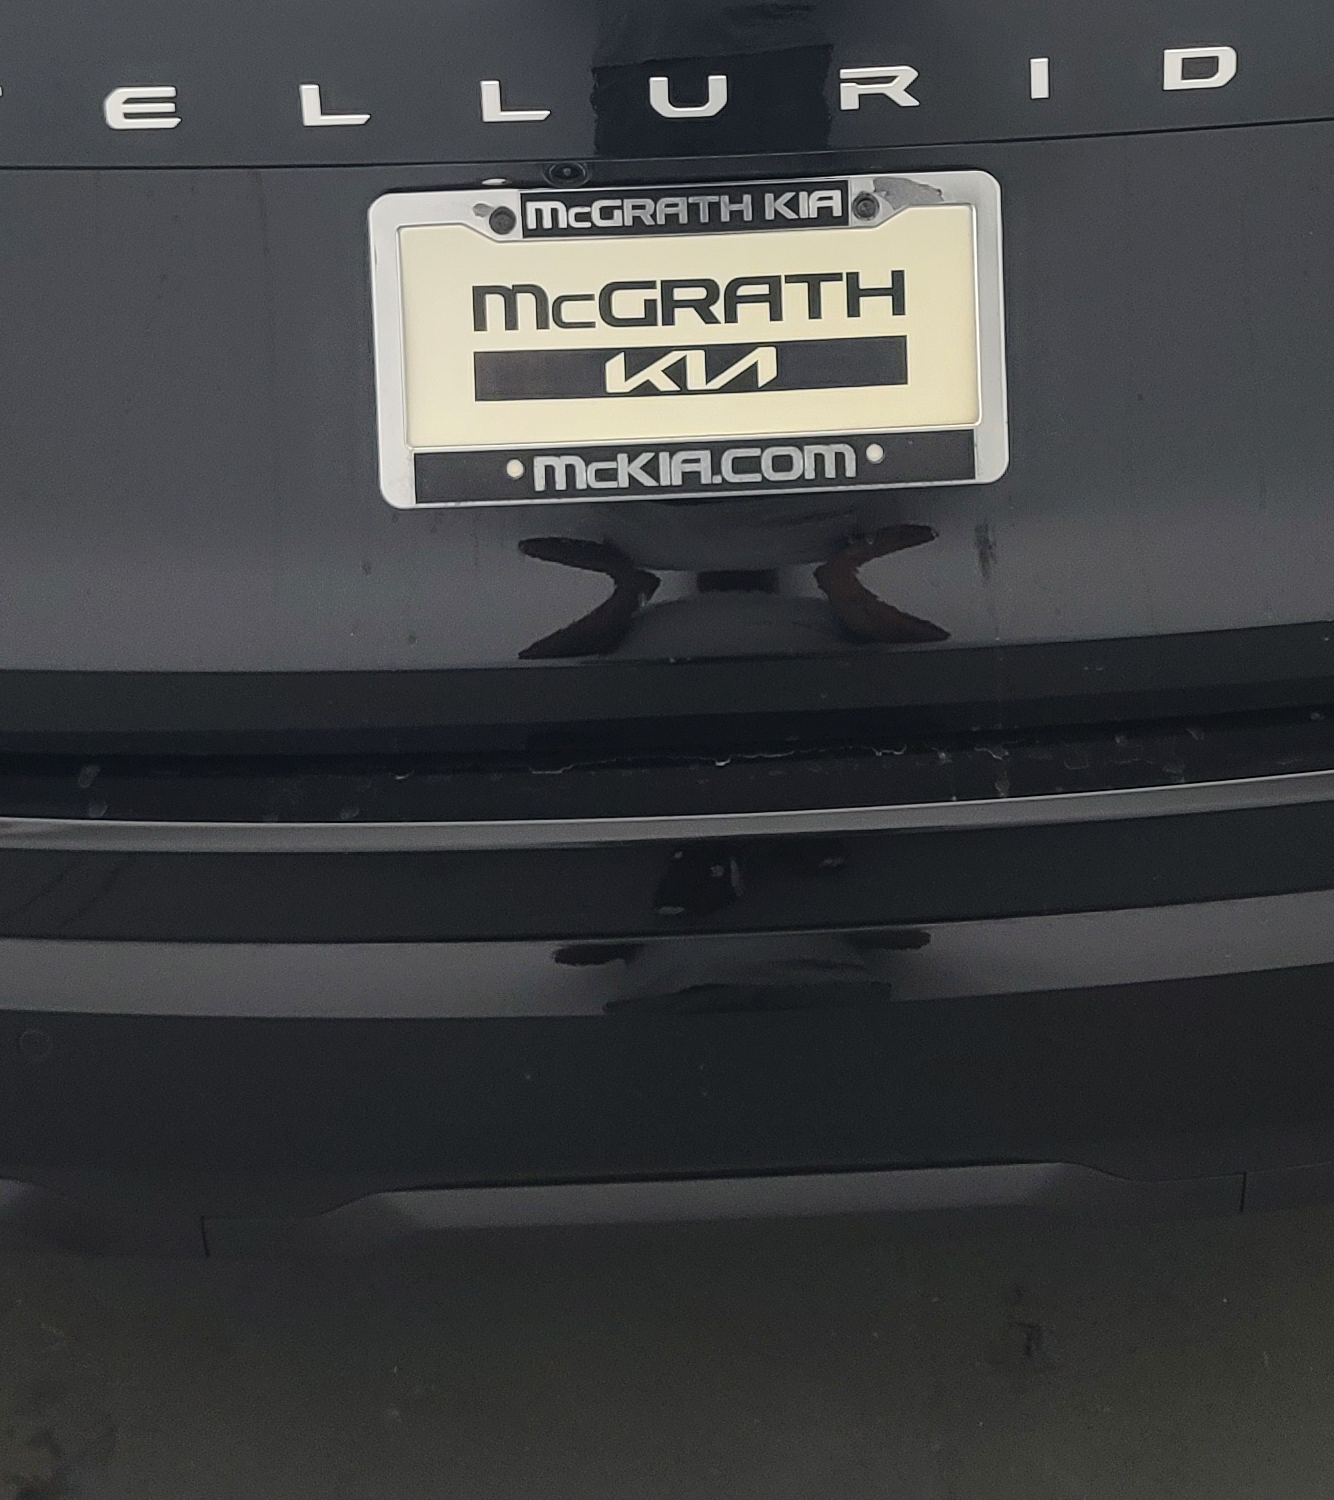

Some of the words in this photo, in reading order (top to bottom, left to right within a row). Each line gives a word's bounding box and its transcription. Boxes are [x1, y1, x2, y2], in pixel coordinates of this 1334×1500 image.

[524, 194, 753, 232] McGRATH
[764, 189, 843, 222] KIA
[471, 269, 907, 333] McGRATH
[604, 346, 778, 394] KIA
[532, 443, 857, 492] McKIA.COM
